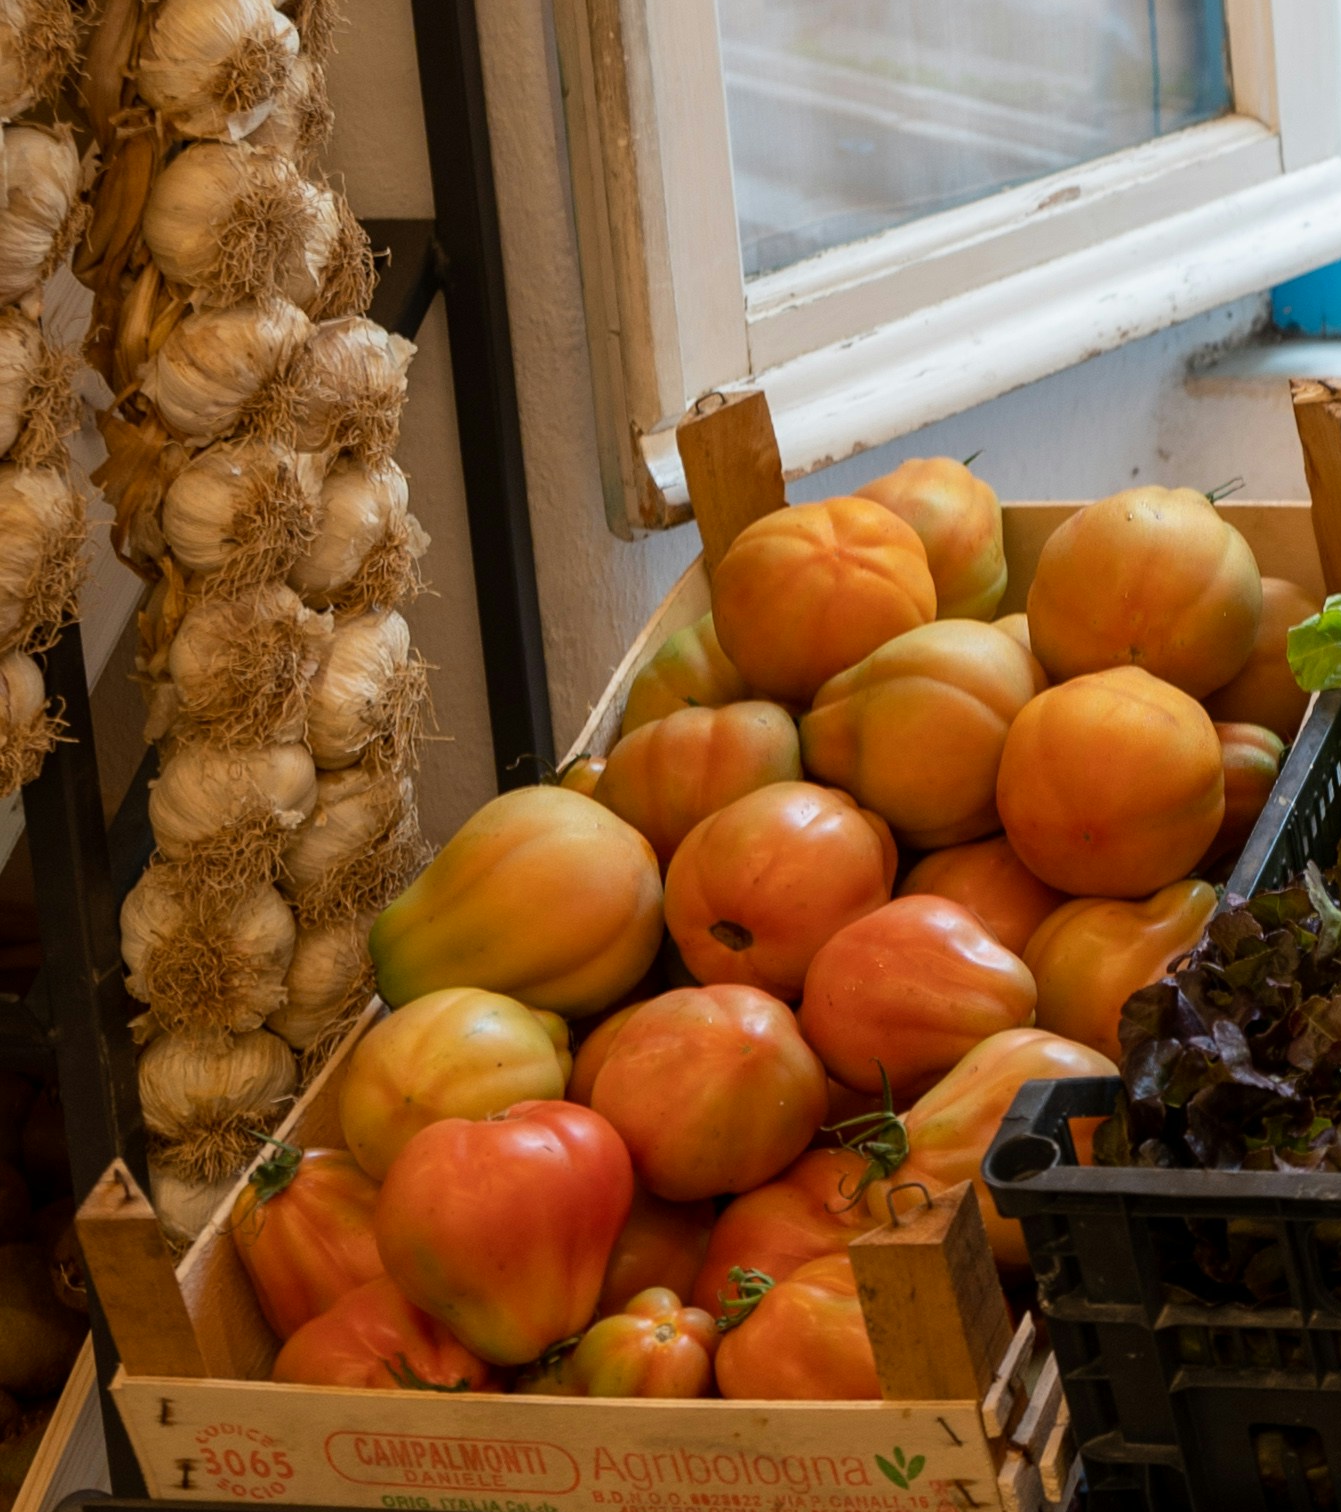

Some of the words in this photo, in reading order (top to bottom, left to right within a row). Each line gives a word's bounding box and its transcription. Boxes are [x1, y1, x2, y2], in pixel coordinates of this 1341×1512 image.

[200, 1447, 294, 1479] 3065
[354, 1437, 547, 1475] CAMPALMONTI
[594, 1446, 873, 1494] Agribologna
[403, 1470, 507, 1488] DANIELE
